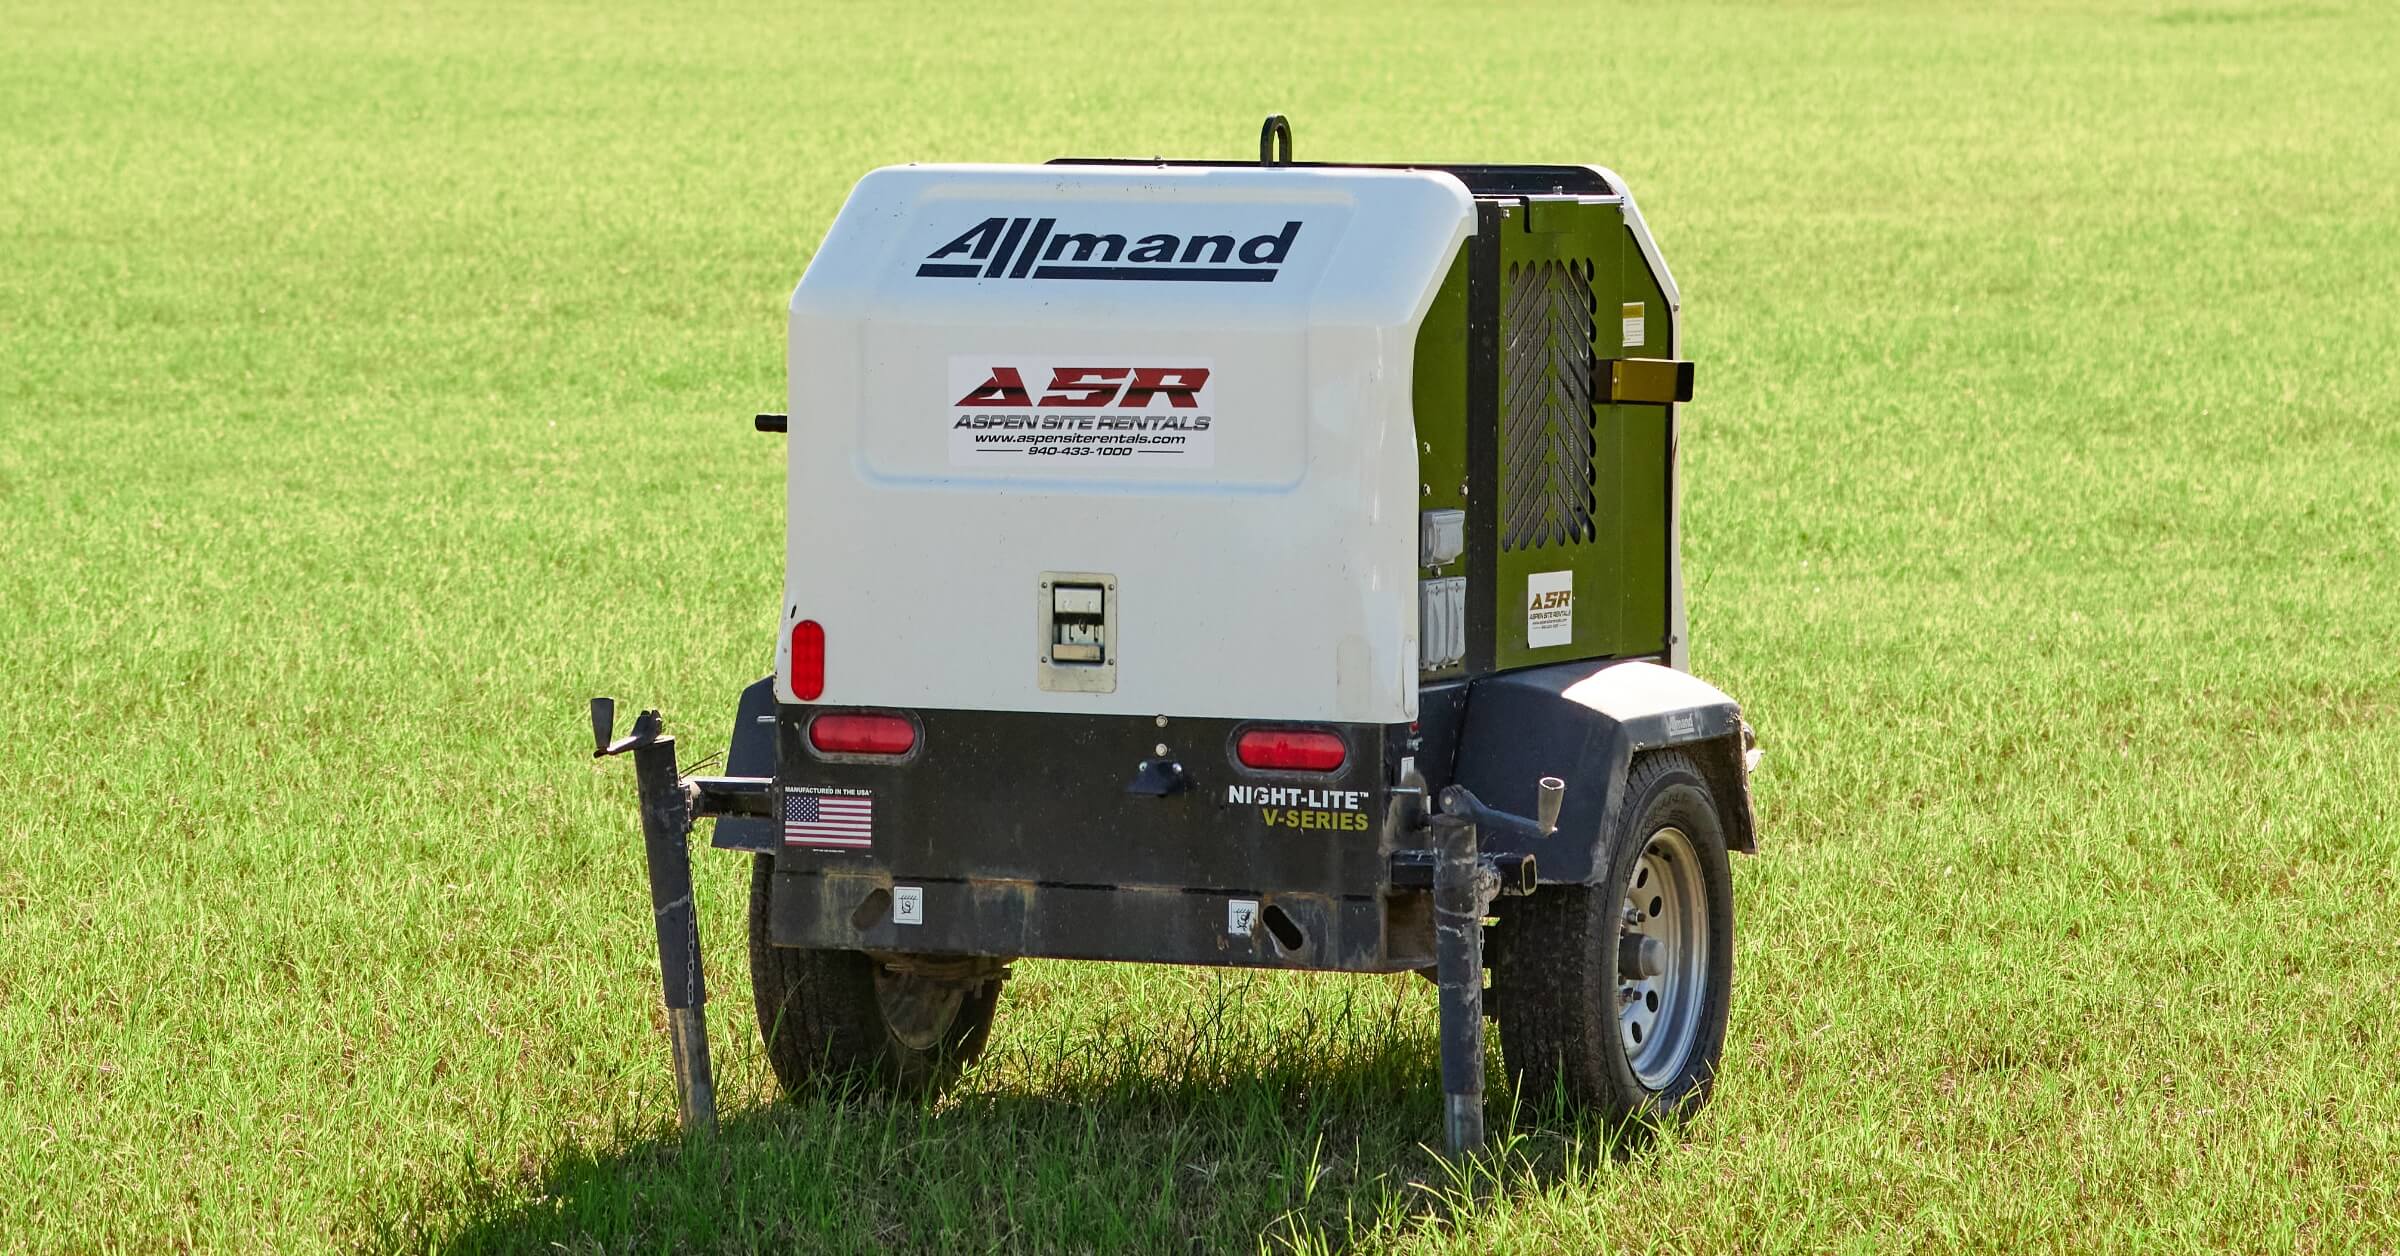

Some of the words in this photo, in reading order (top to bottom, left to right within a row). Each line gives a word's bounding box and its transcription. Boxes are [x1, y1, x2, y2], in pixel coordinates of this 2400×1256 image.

[916, 217, 1303, 281] Allmand
[953, 367, 1210, 408] ASR
[953, 414, 1040, 430] ASPEN
[1041, 415, 1096, 431] SITE
[1096, 415, 1212, 431] RENTALS
[975, 432, 1186, 446] www.aspensiterentals.com
[1028, 446, 1133, 457] 940-433-1000
[1529, 590, 1571, 610] ASR
[784, 786, 834, 795] MANUFACTURED
[1262, 808, 1369, 831] V-SERIES
